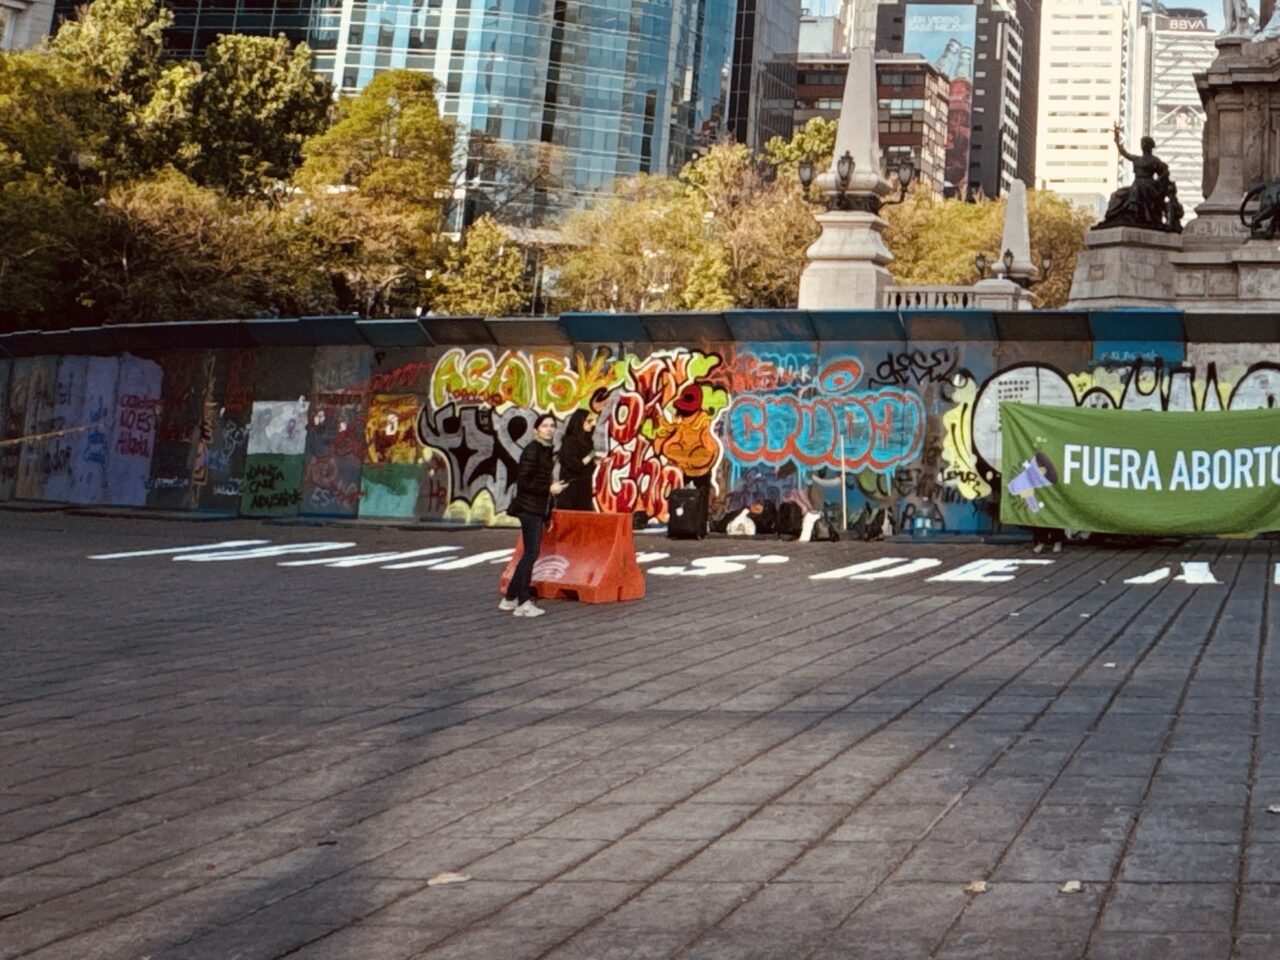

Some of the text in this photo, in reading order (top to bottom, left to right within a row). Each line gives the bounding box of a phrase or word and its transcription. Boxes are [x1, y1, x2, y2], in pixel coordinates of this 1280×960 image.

[1169, 19, 1206, 30] BBVA
[1063, 444, 1161, 491] FUERA
[808, 556, 1055, 582] DE
